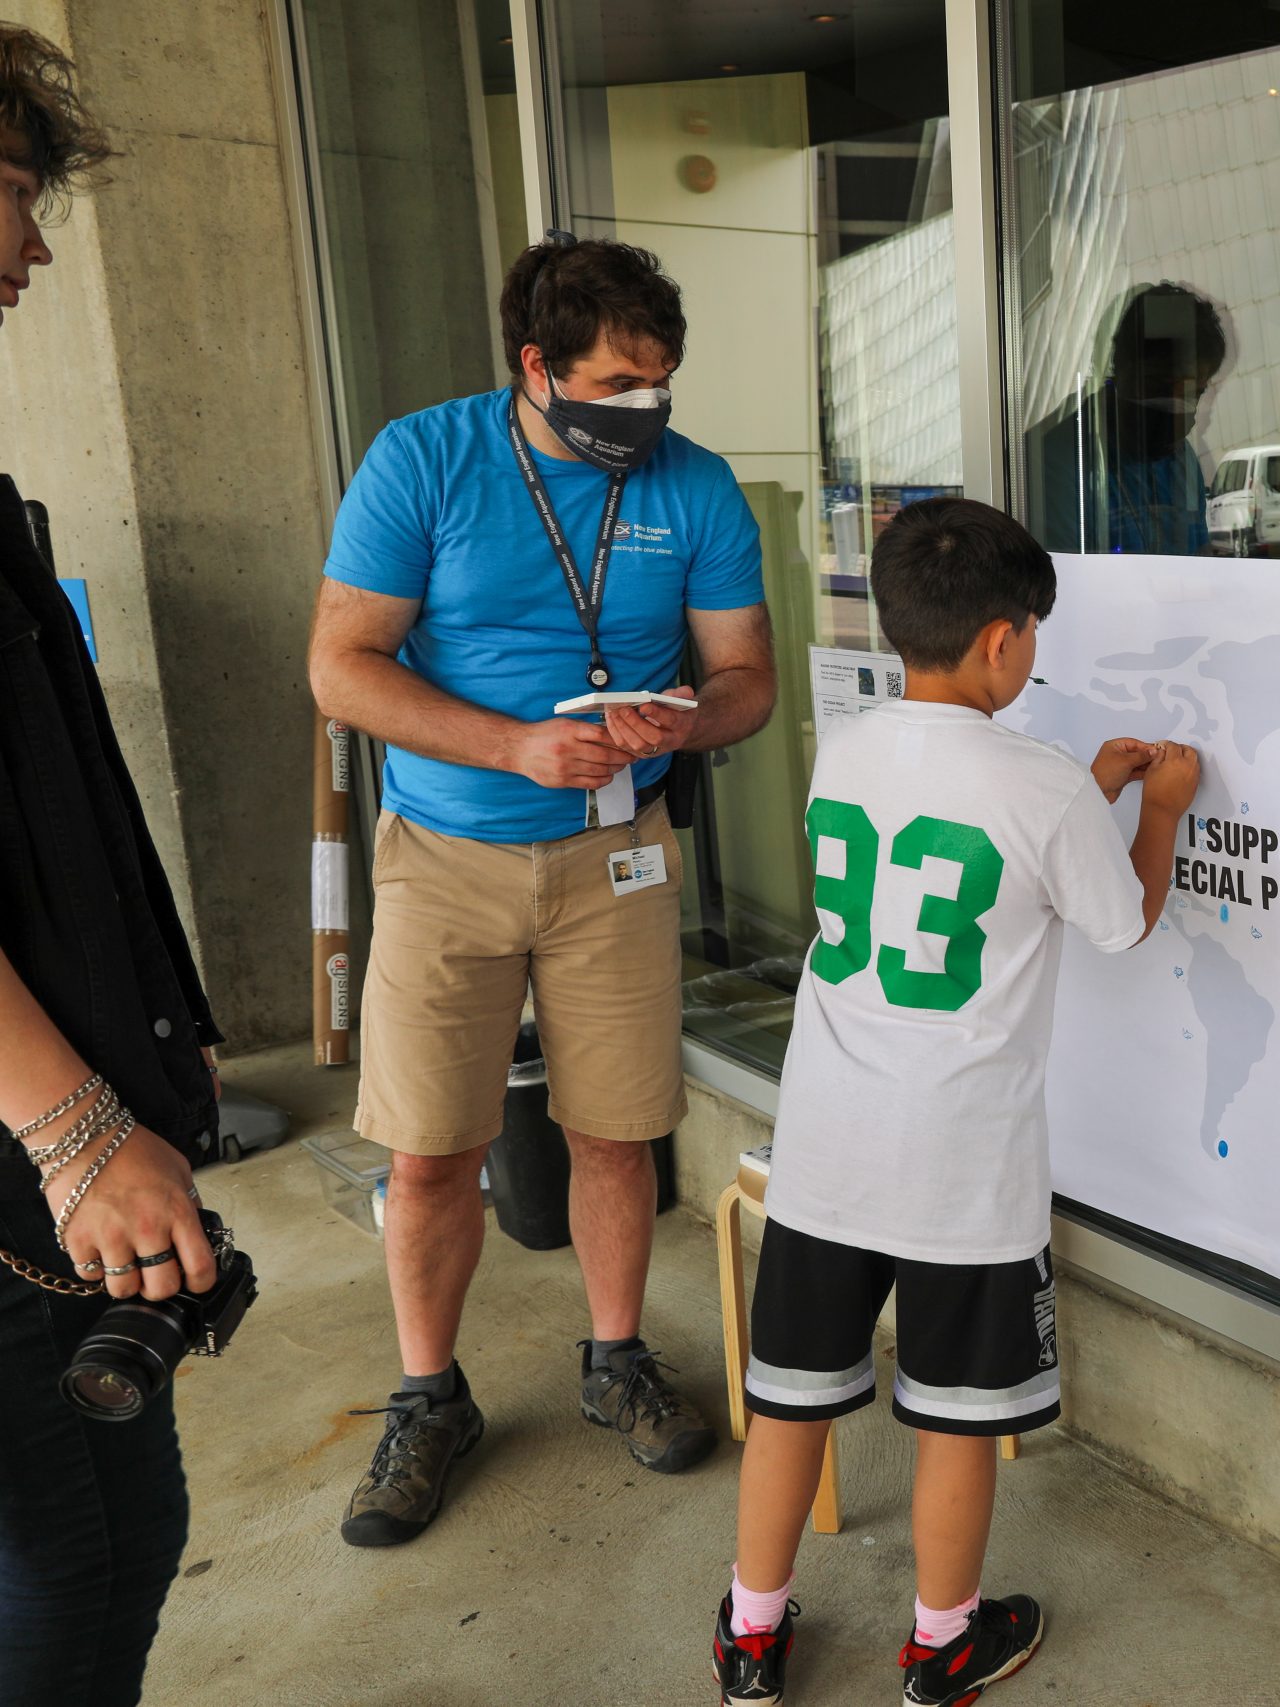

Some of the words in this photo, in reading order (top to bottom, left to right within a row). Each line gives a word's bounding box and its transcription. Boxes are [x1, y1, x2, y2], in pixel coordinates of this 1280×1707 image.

[594, 444, 624, 457] Aquarium
[611, 444, 634, 452] England
[608, 496, 616, 517] England
[544, 512, 557, 534] England
[602, 516, 612, 540] Aquarium
[634, 524, 646, 532] New
[647, 526, 672, 534] England
[634, 532, 662, 541] Aquarium
[594, 560, 604, 580] England
[591, 580, 601, 604] Aquarium
[338, 743, 348, 790] SIGNS
[1188, 815, 1195, 848] I
[1175, 856, 1252, 906] ECIAL
[338, 980, 348, 1028] SIGNS
